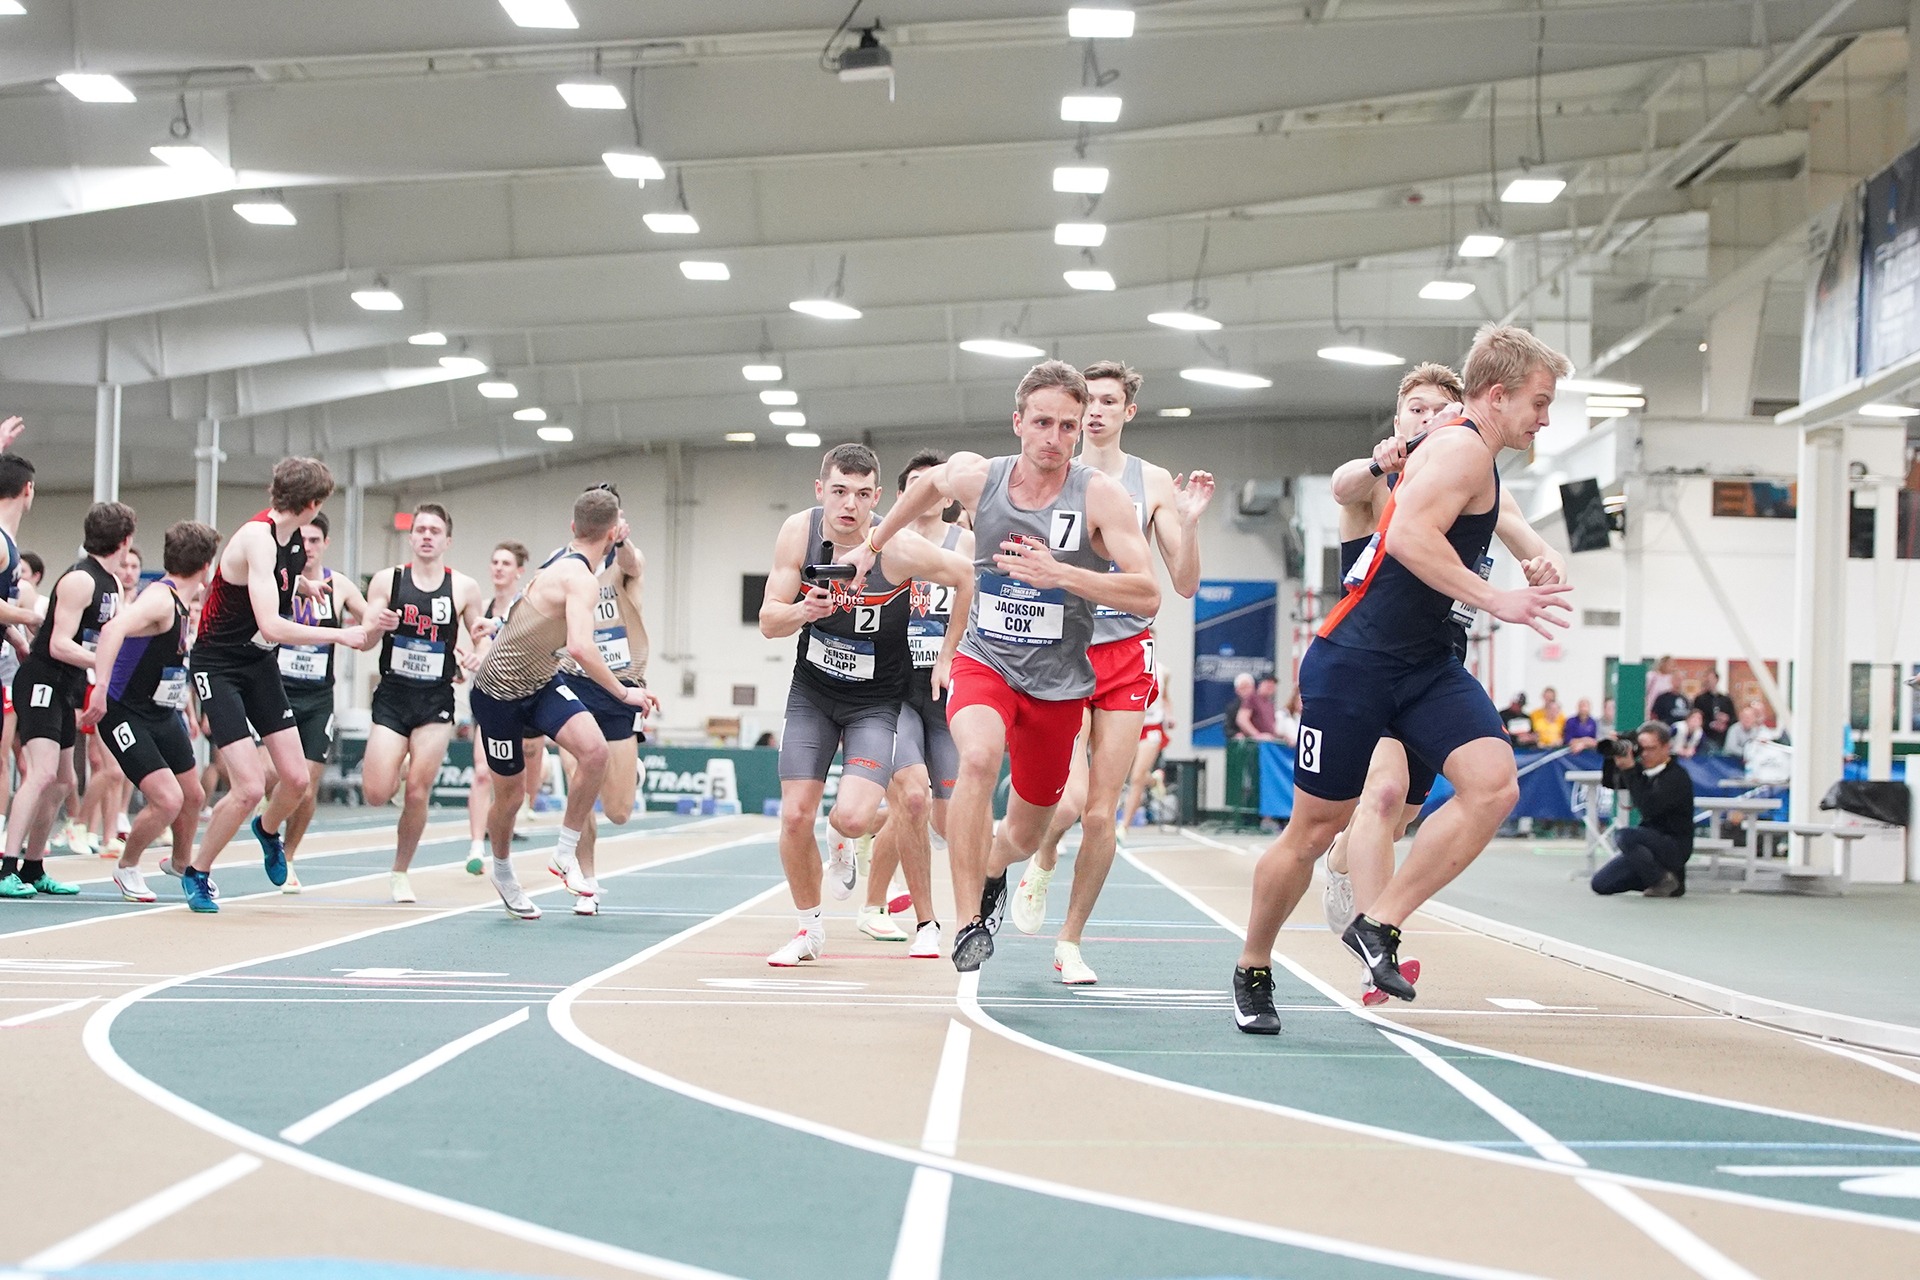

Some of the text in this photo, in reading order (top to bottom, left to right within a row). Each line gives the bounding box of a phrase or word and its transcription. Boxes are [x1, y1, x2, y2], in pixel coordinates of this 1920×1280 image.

[1059, 513, 1076, 548] 7
[829, 591, 865, 606] ights
[935, 585, 949, 612] 2
[437, 602, 447, 622] 3
[598, 602, 615, 620] 10
[994, 601, 1045, 617] JACKSON
[403, 603, 440, 643] RPI
[860, 608, 876, 631] 2
[1005, 617, 1032, 633] COX
[910, 639, 922, 648] ATT
[603, 651, 621, 663] SON
[823, 654, 857, 672] CLAPP
[824, 648, 857, 661] JENSEN
[38, 687, 46, 704] 1
[196, 675, 207, 698] 3
[118, 726, 131, 746] 6
[492, 741, 509, 759] 10
[1303, 730, 1315, 768] 8
[646, 770, 705, 792] TRAC
